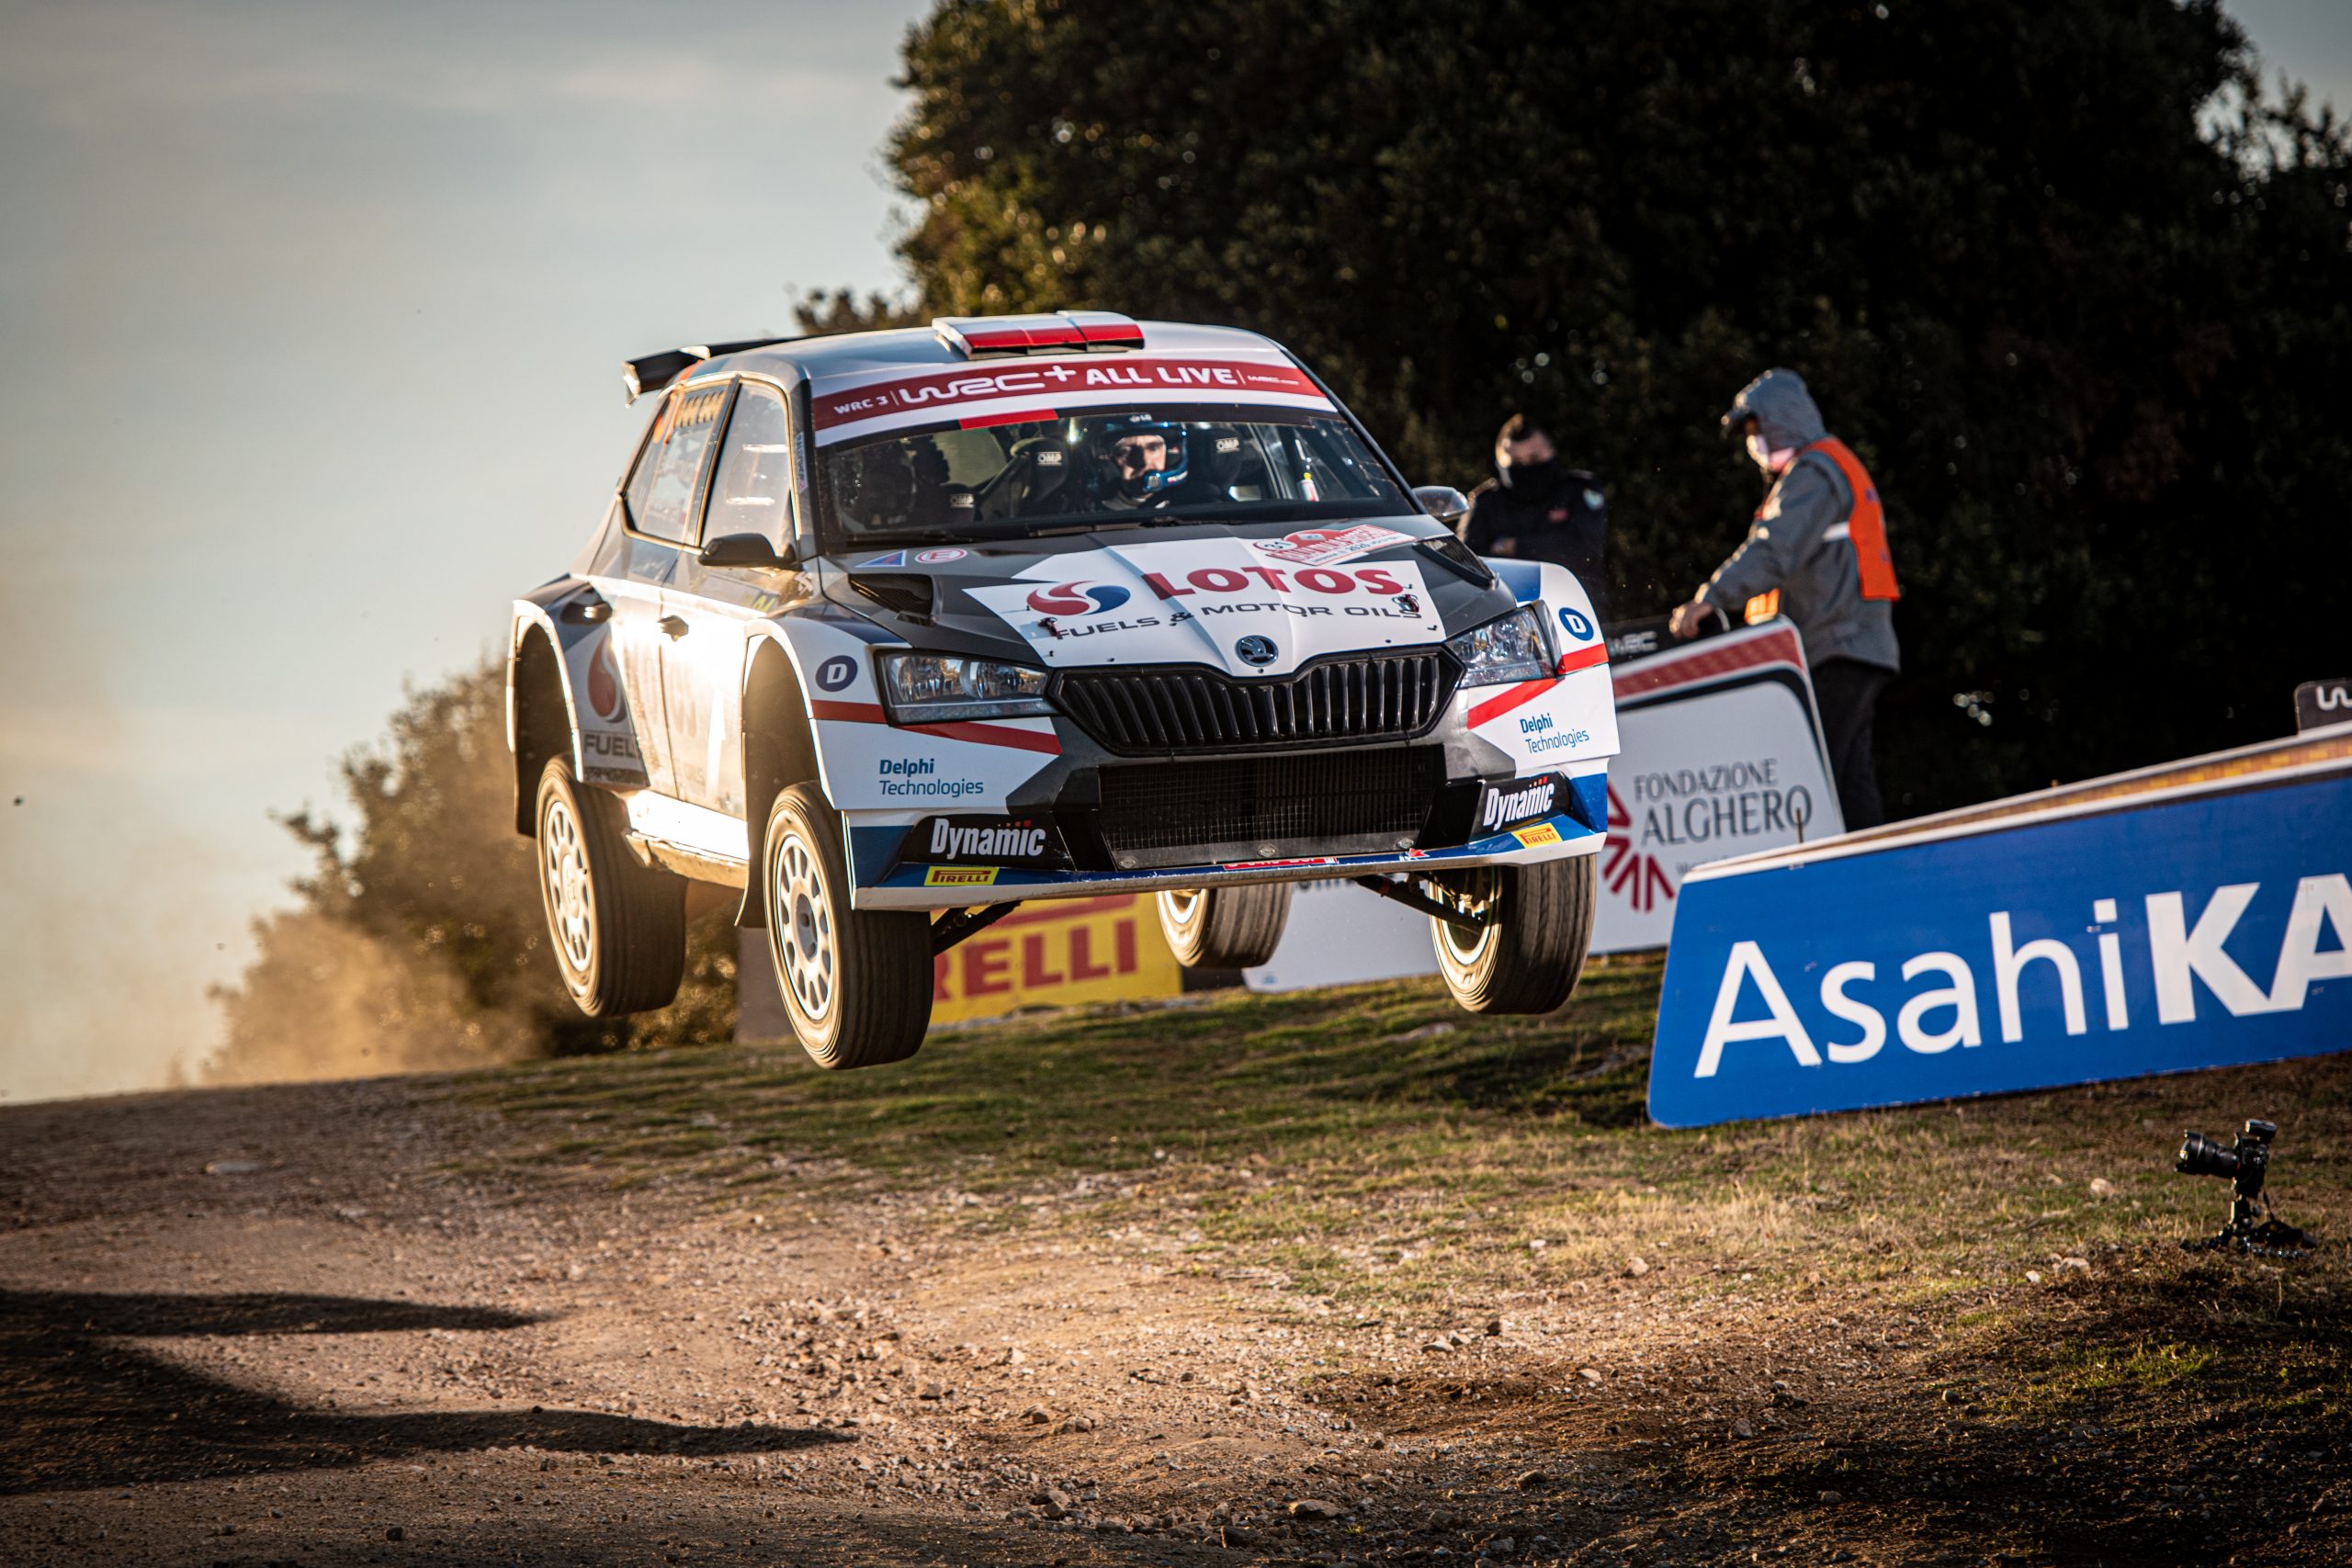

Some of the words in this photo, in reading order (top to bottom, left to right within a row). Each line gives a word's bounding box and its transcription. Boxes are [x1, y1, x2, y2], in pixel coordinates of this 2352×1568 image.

[833, 399, 874, 414] WRC
[876, 396, 889, 407] 3
[1086, 367, 1153, 386] ALL
[1156, 367, 1238, 386] LIVE
[1142, 566, 1405, 601] LOTOS
[1056, 616, 1161, 640] FUELS
[1170, 611, 1195, 624] &
[1201, 603, 1332, 617] MOTOR
[1344, 605, 1422, 619] OILS
[1520, 713, 1554, 734] Delphi
[1525, 728, 1590, 753] Technologies
[879, 758, 935, 778] Delphi
[1634, 758, 1779, 804] FONDAZIONE
[879, 778, 984, 798] Technologies
[1483, 783, 1555, 831] Dynamic
[1640, 784, 1812, 847] ALGHERO
[930, 818, 1046, 860] Dynamic
[1520, 828, 1556, 845] PIRELLI
[932, 870, 992, 883] PIRELLI
[933, 919, 1137, 1001] ELLI
